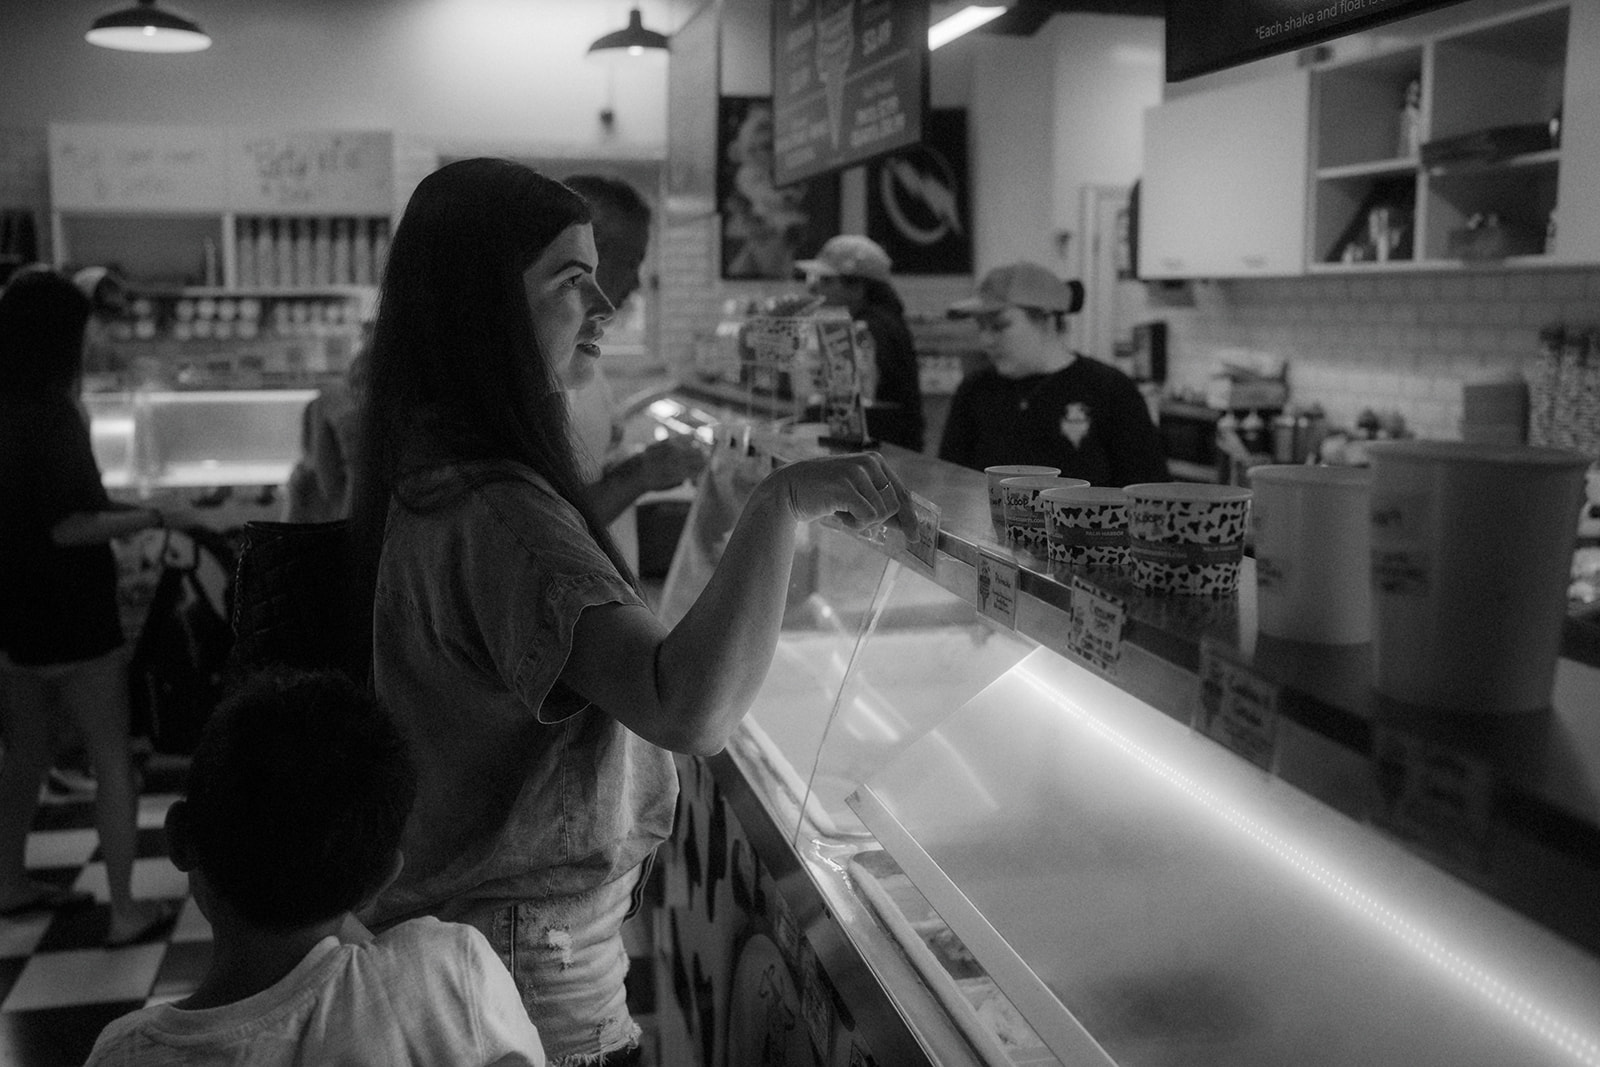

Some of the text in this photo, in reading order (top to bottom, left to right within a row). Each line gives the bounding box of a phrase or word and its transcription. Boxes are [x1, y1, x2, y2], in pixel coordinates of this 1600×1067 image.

[1284, 12, 1314, 32] shake
[1317, 3, 1337, 22] and
[1340, 0, 1365, 14] float
